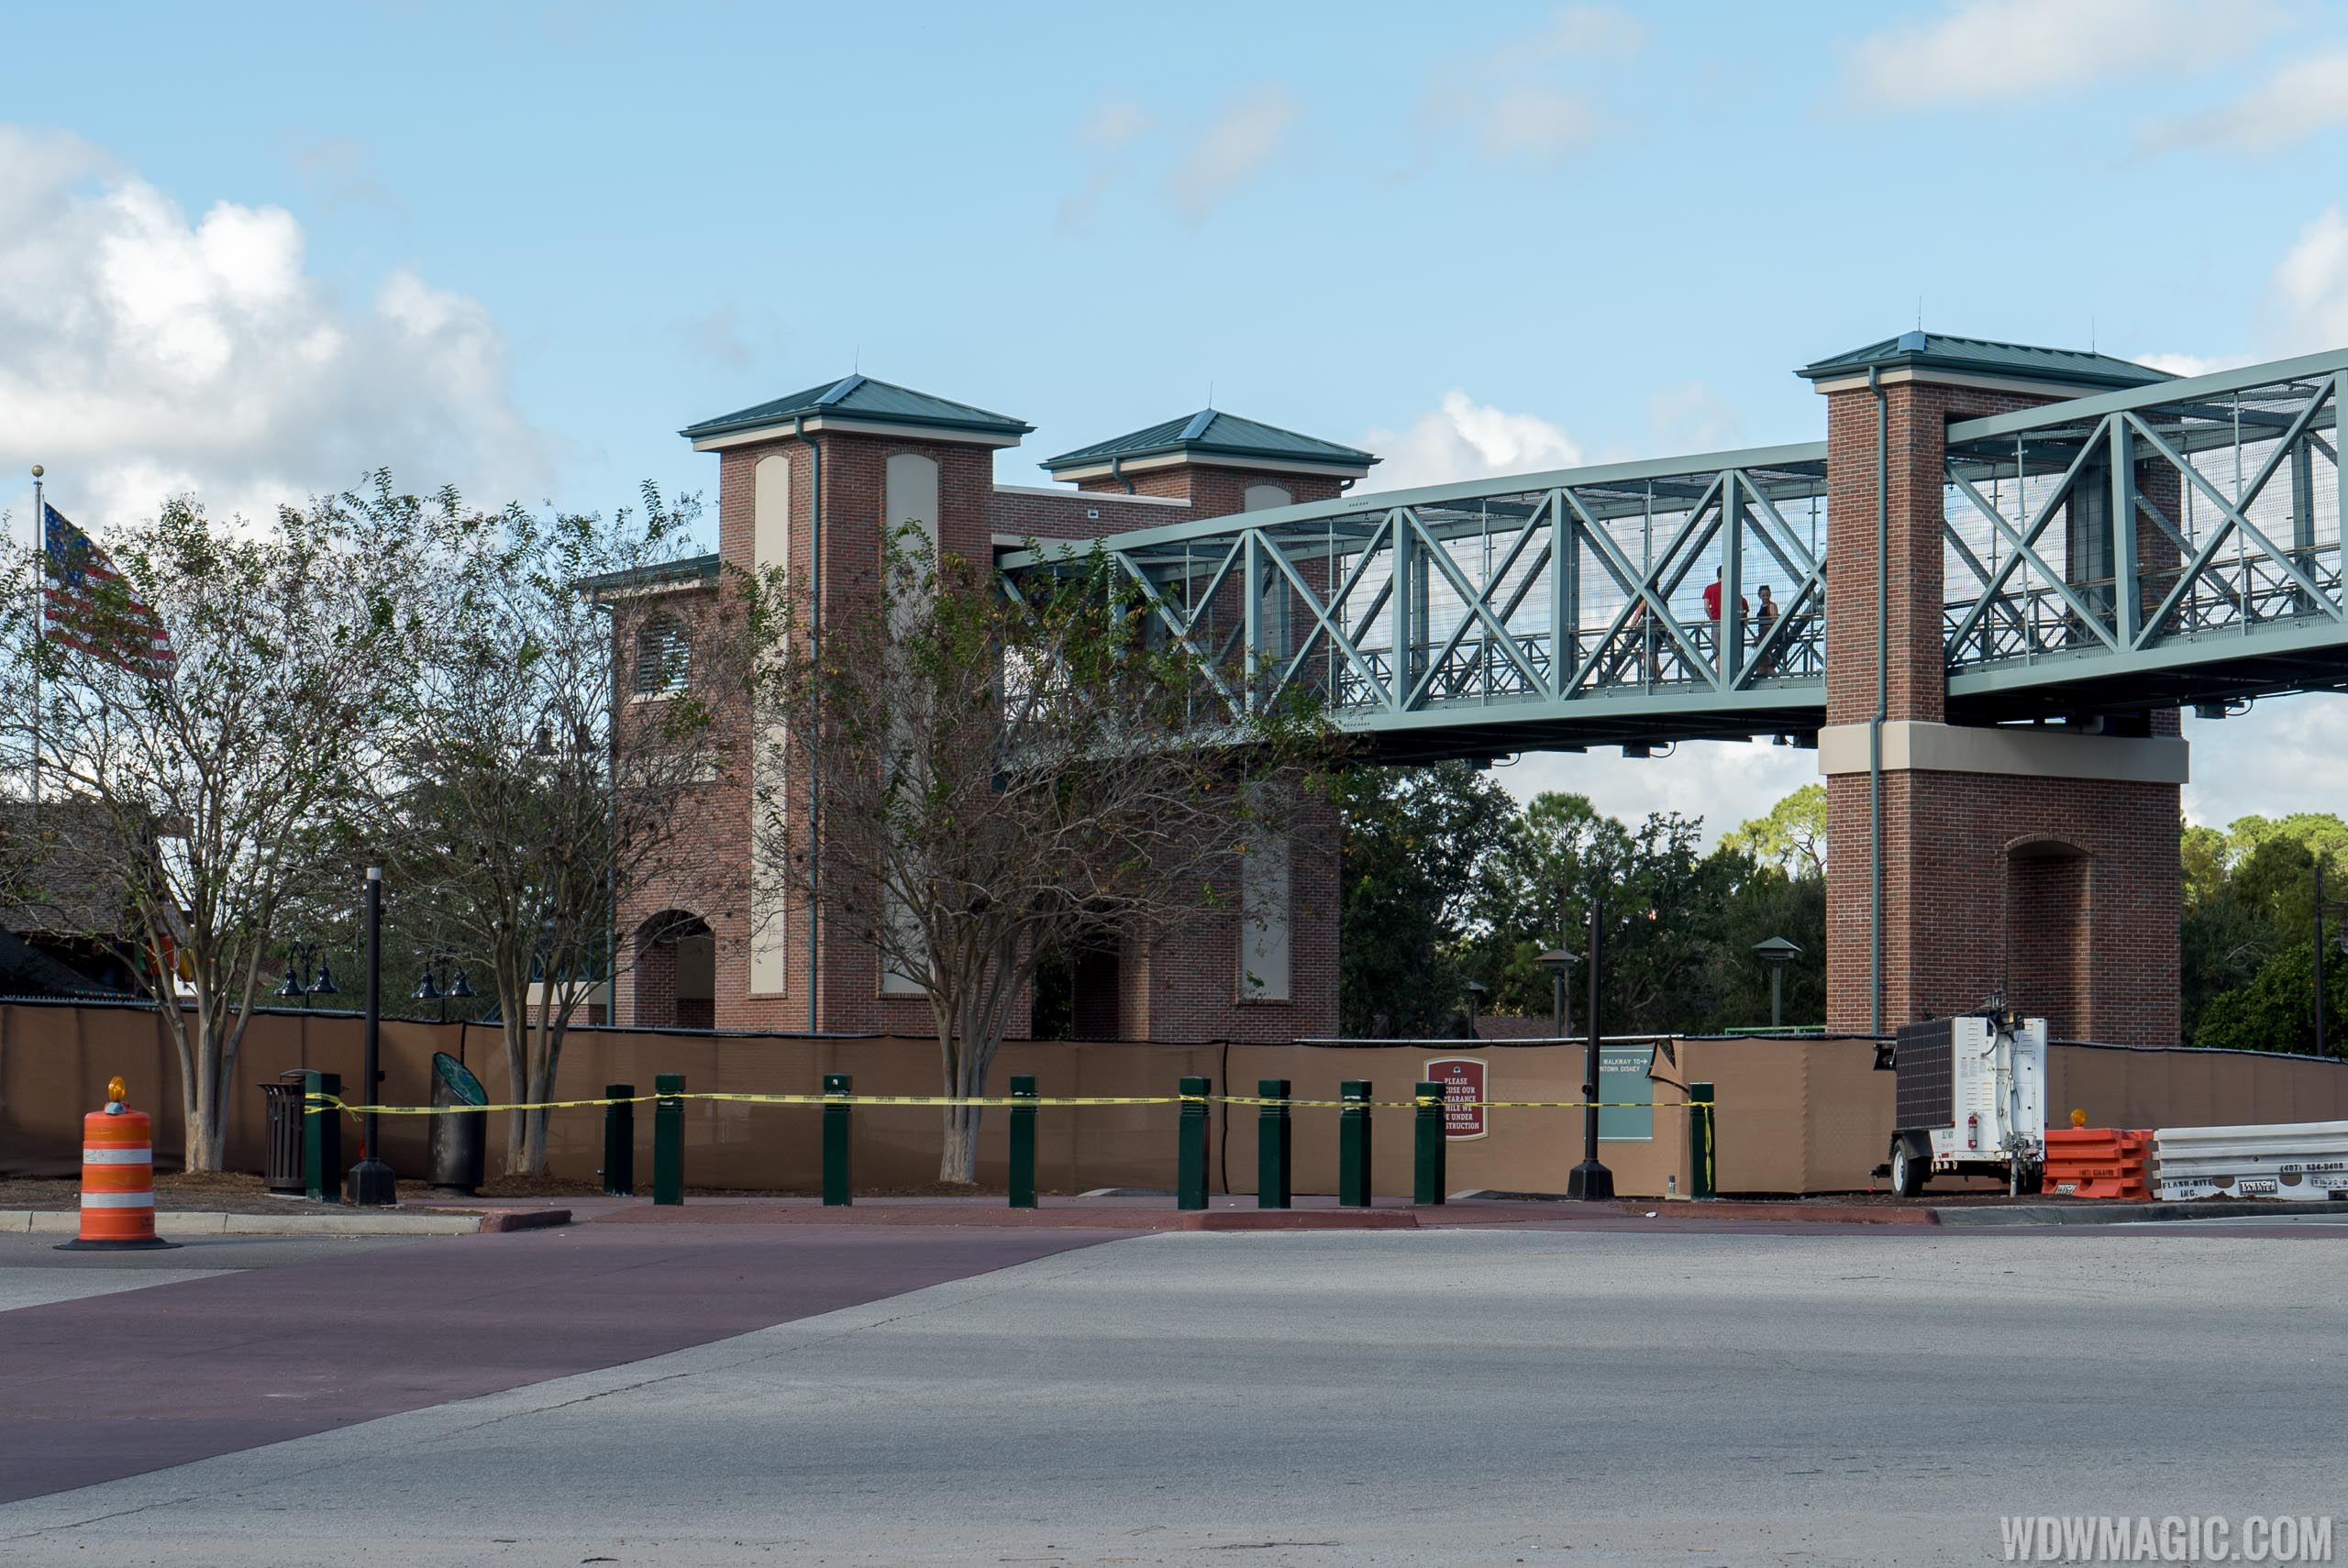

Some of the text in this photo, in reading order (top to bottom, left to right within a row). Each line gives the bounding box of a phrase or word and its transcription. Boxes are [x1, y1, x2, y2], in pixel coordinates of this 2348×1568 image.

[1461, 1086, 1476, 1094] OUR
[1445, 1103, 1460, 1111] HILE
[2280, 1164, 2302, 1173] (407)
[2163, 1178, 2213, 1189] FLASH-RITE
[2180, 1189, 2198, 1198] INC.
